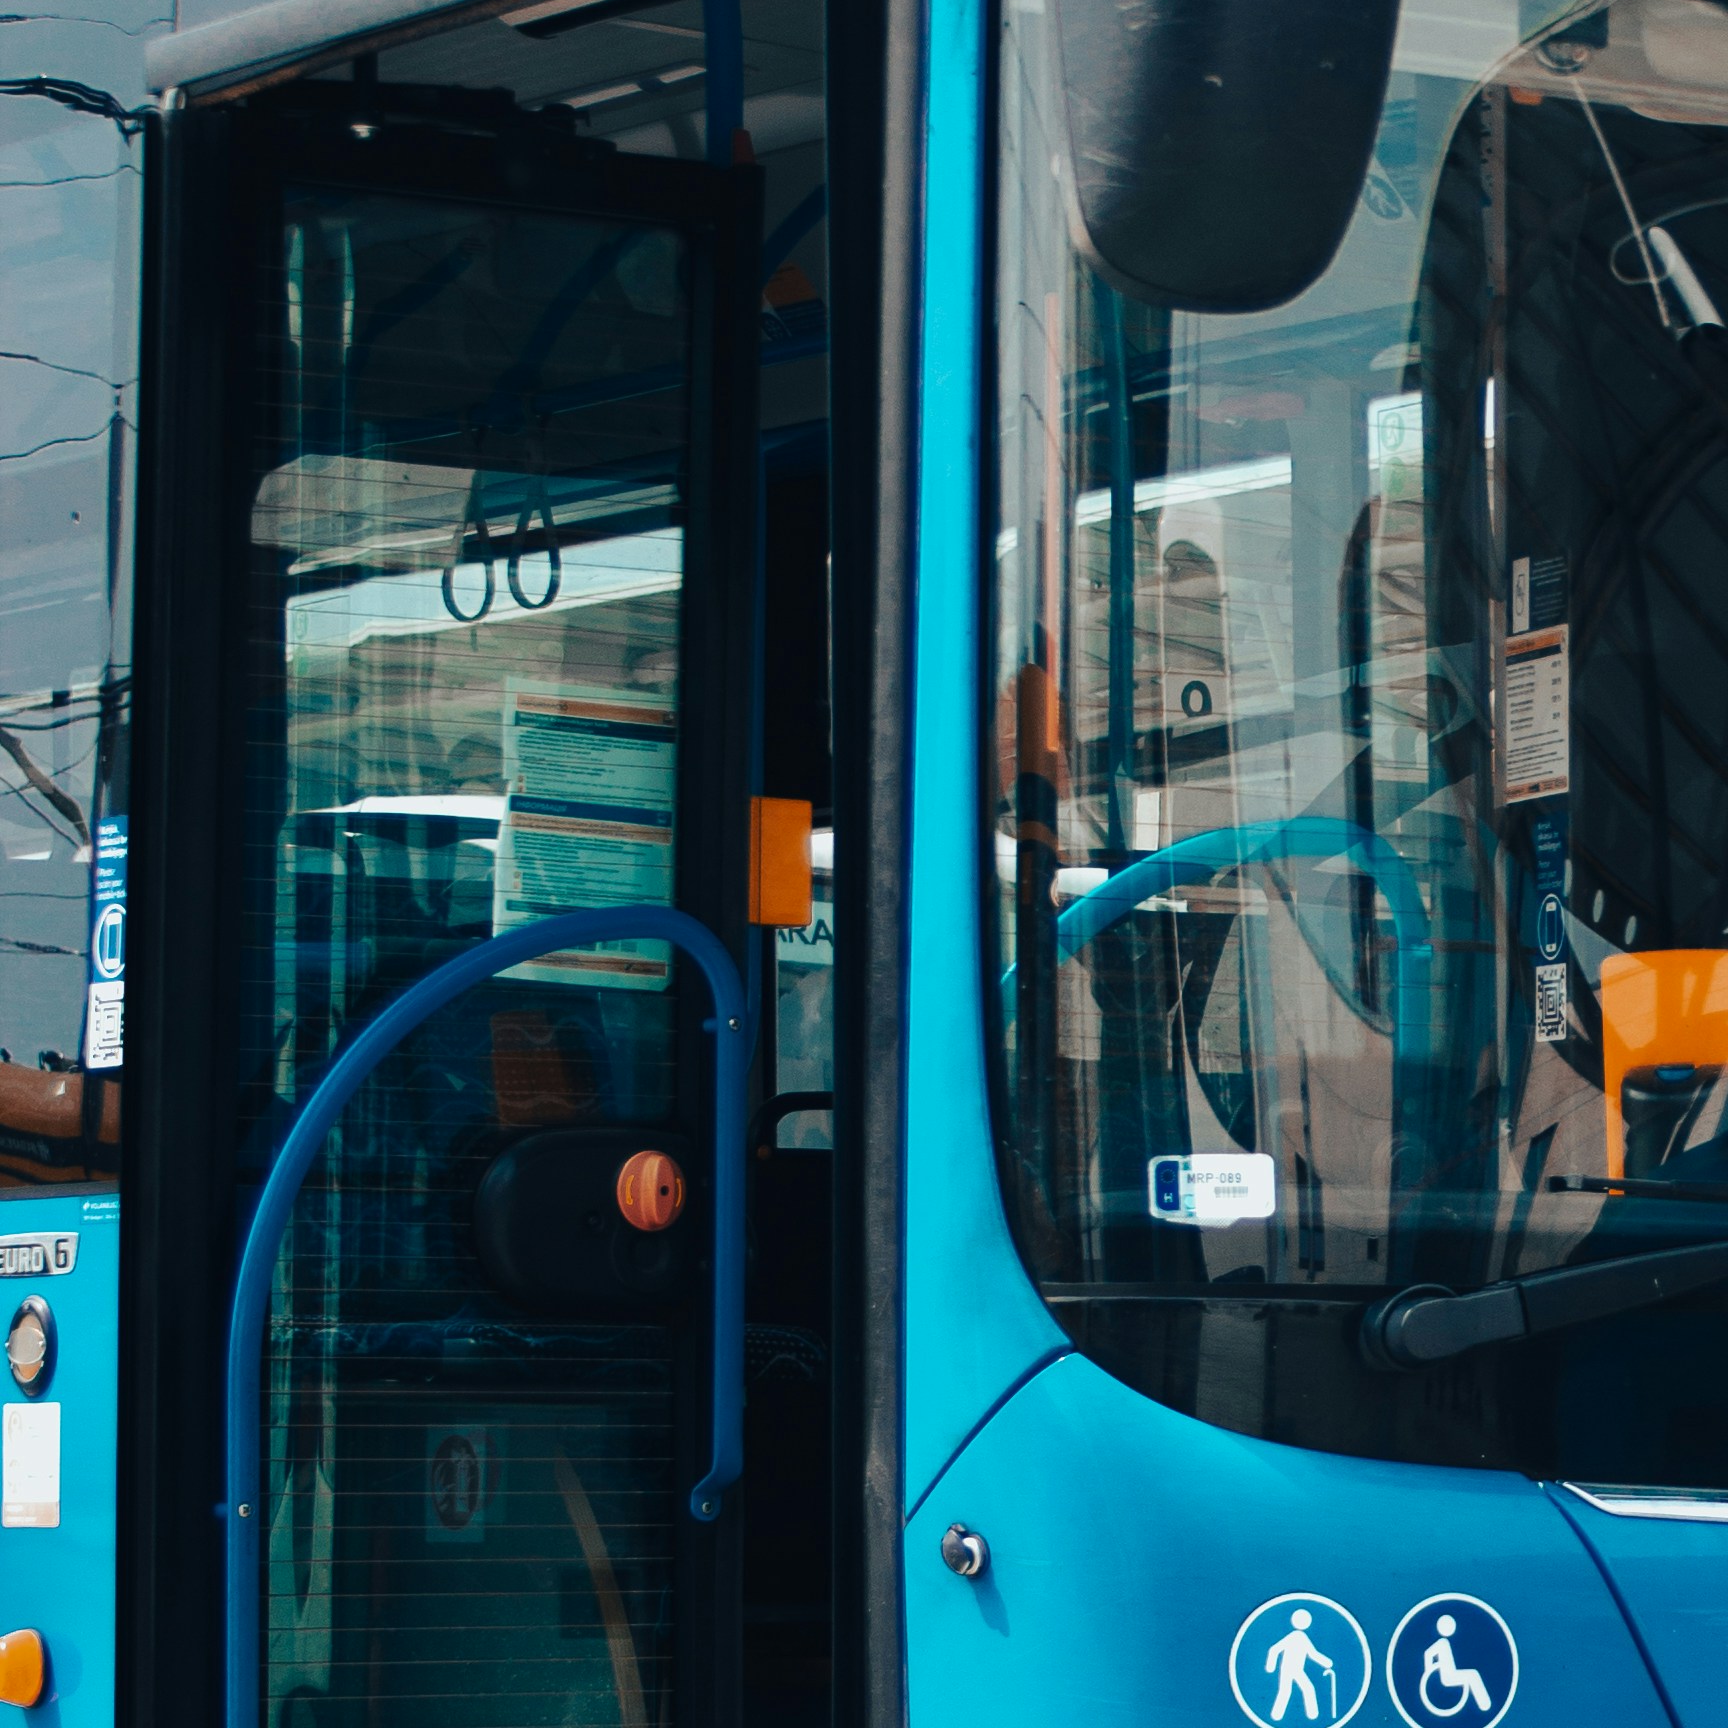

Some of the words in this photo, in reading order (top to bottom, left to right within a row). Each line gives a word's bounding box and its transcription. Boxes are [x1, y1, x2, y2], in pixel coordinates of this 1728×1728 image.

[1187, 1172, 1242, 1184] MRP-089
[1163, 1192, 1173, 1203] H
[55, 1238, 69, 1269] 6
